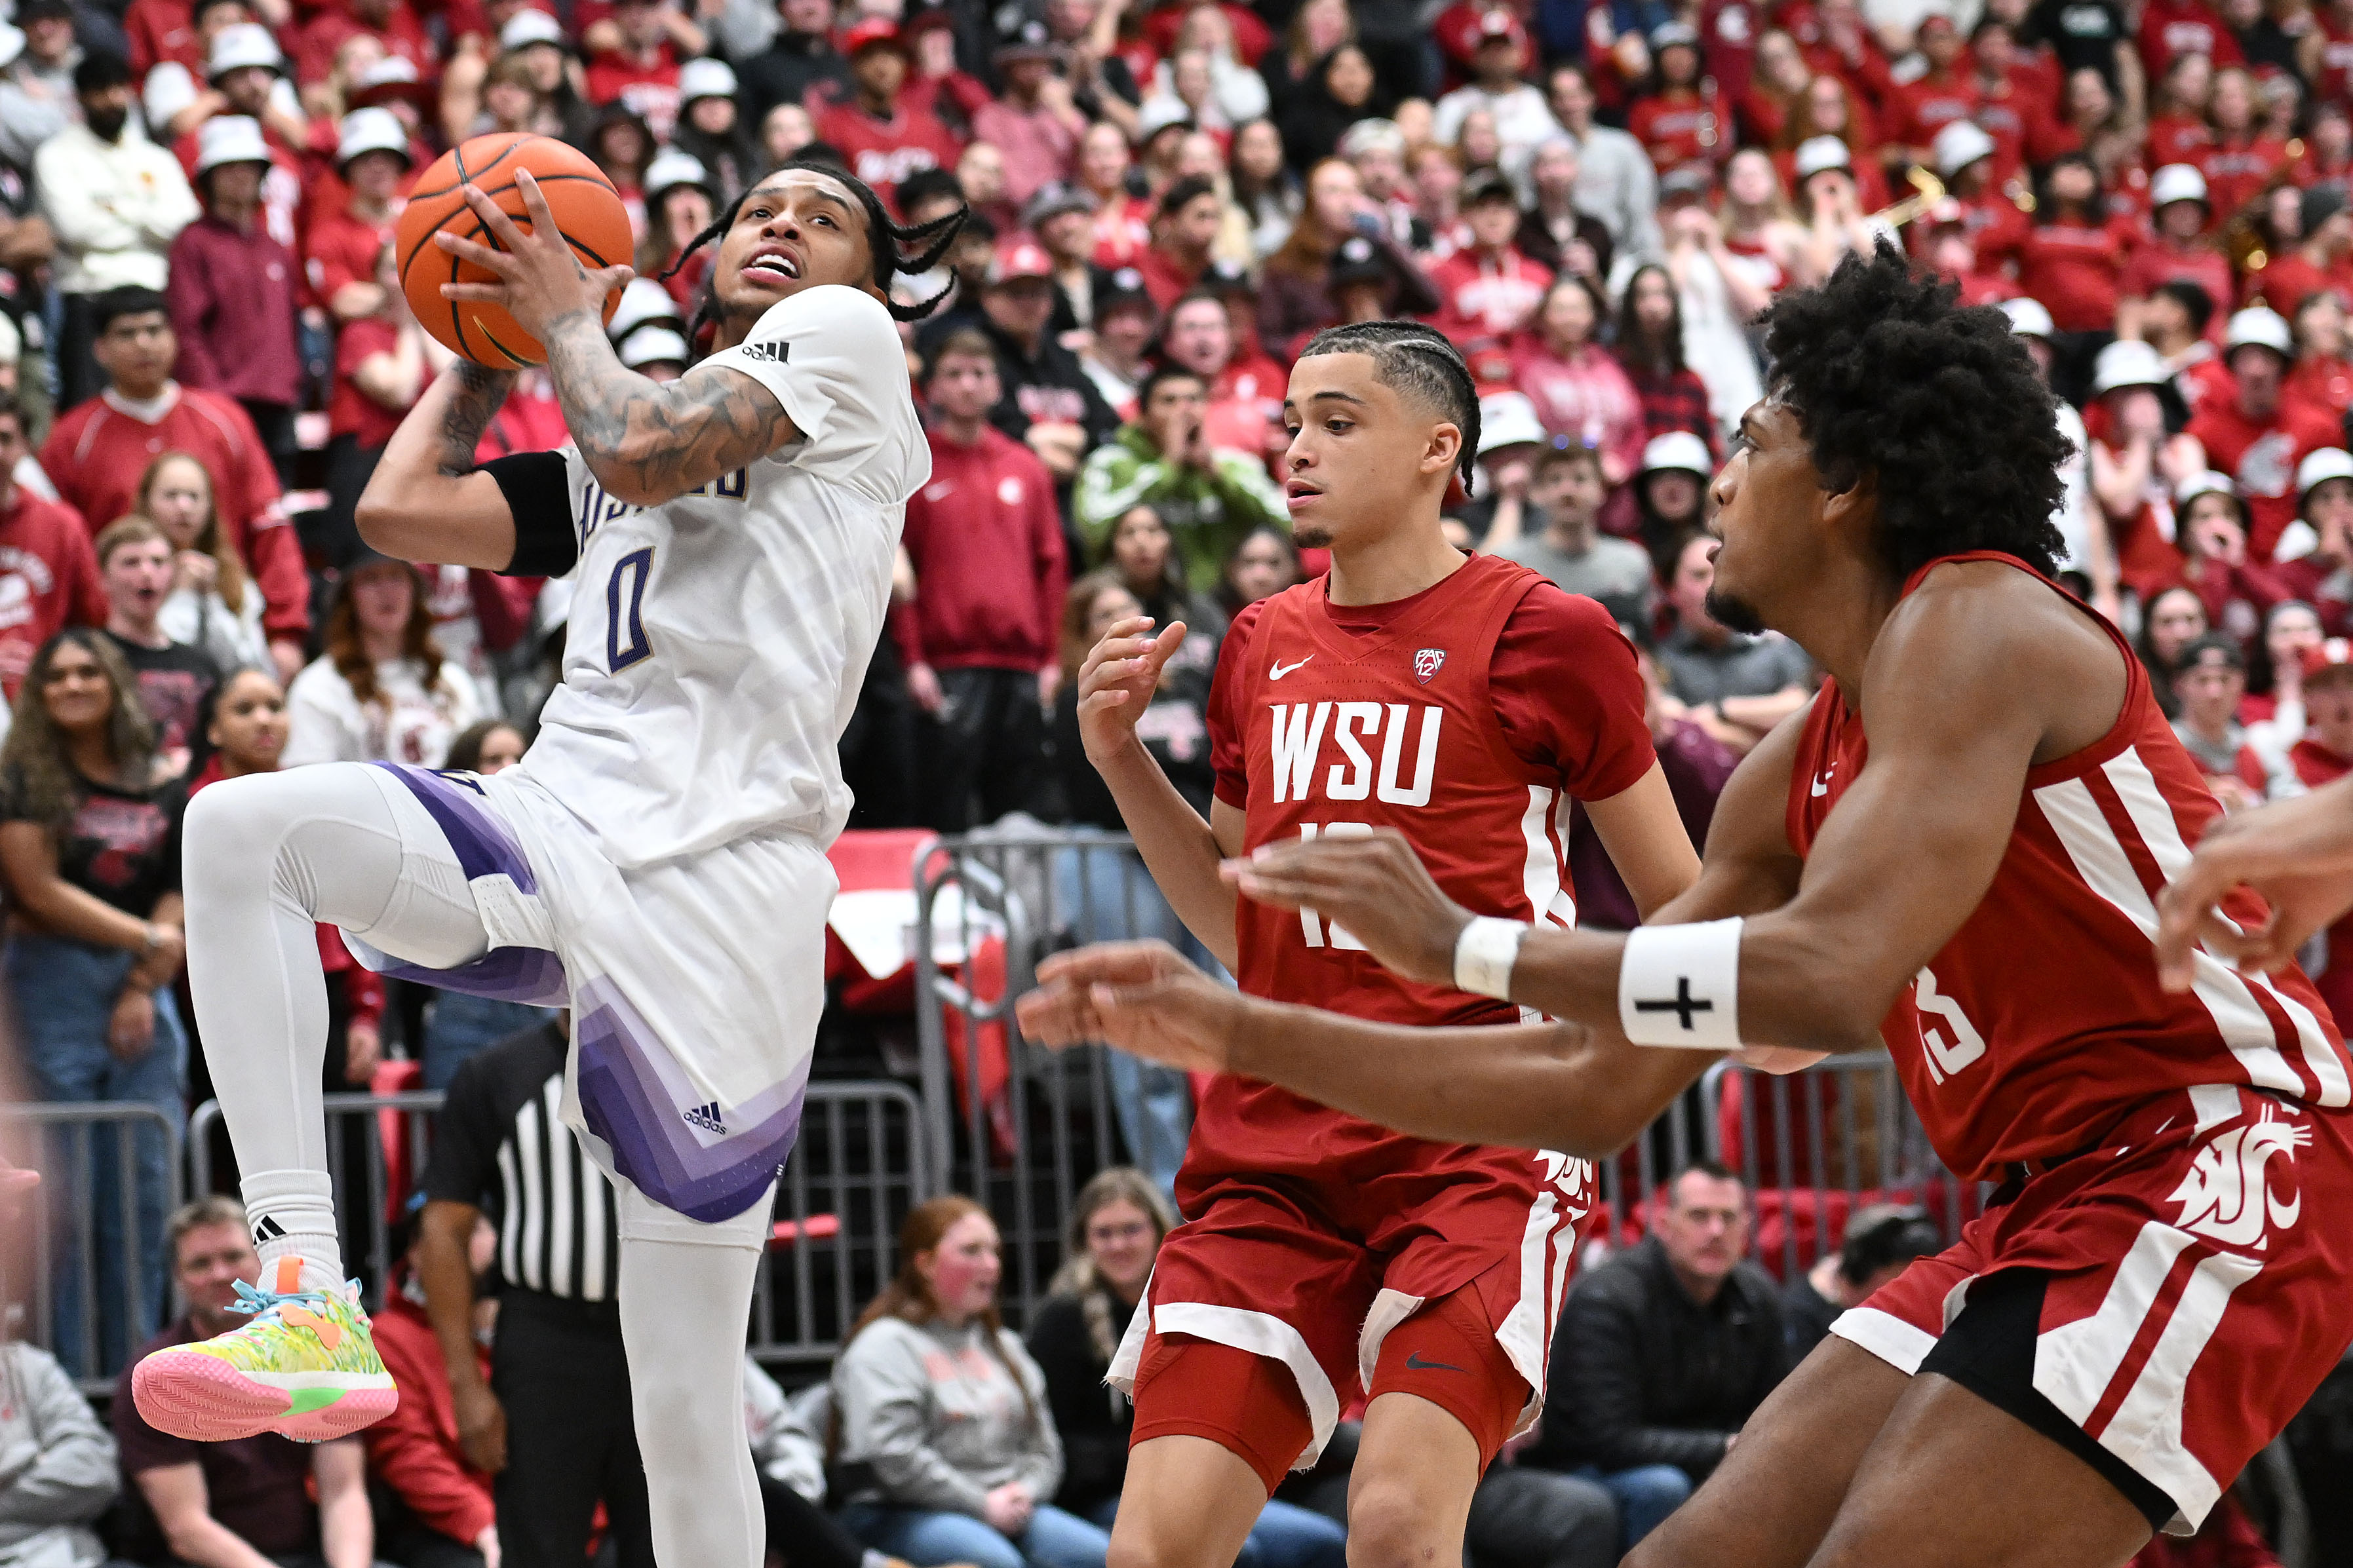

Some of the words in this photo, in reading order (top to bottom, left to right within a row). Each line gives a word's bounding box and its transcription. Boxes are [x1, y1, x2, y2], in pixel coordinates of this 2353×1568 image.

[606, 546, 656, 678] 0
[1416, 649, 1445, 670] PAC
[1418, 662, 1435, 676] 12
[1269, 701, 1443, 807] WSU
[684, 1111, 727, 1136] adidas
